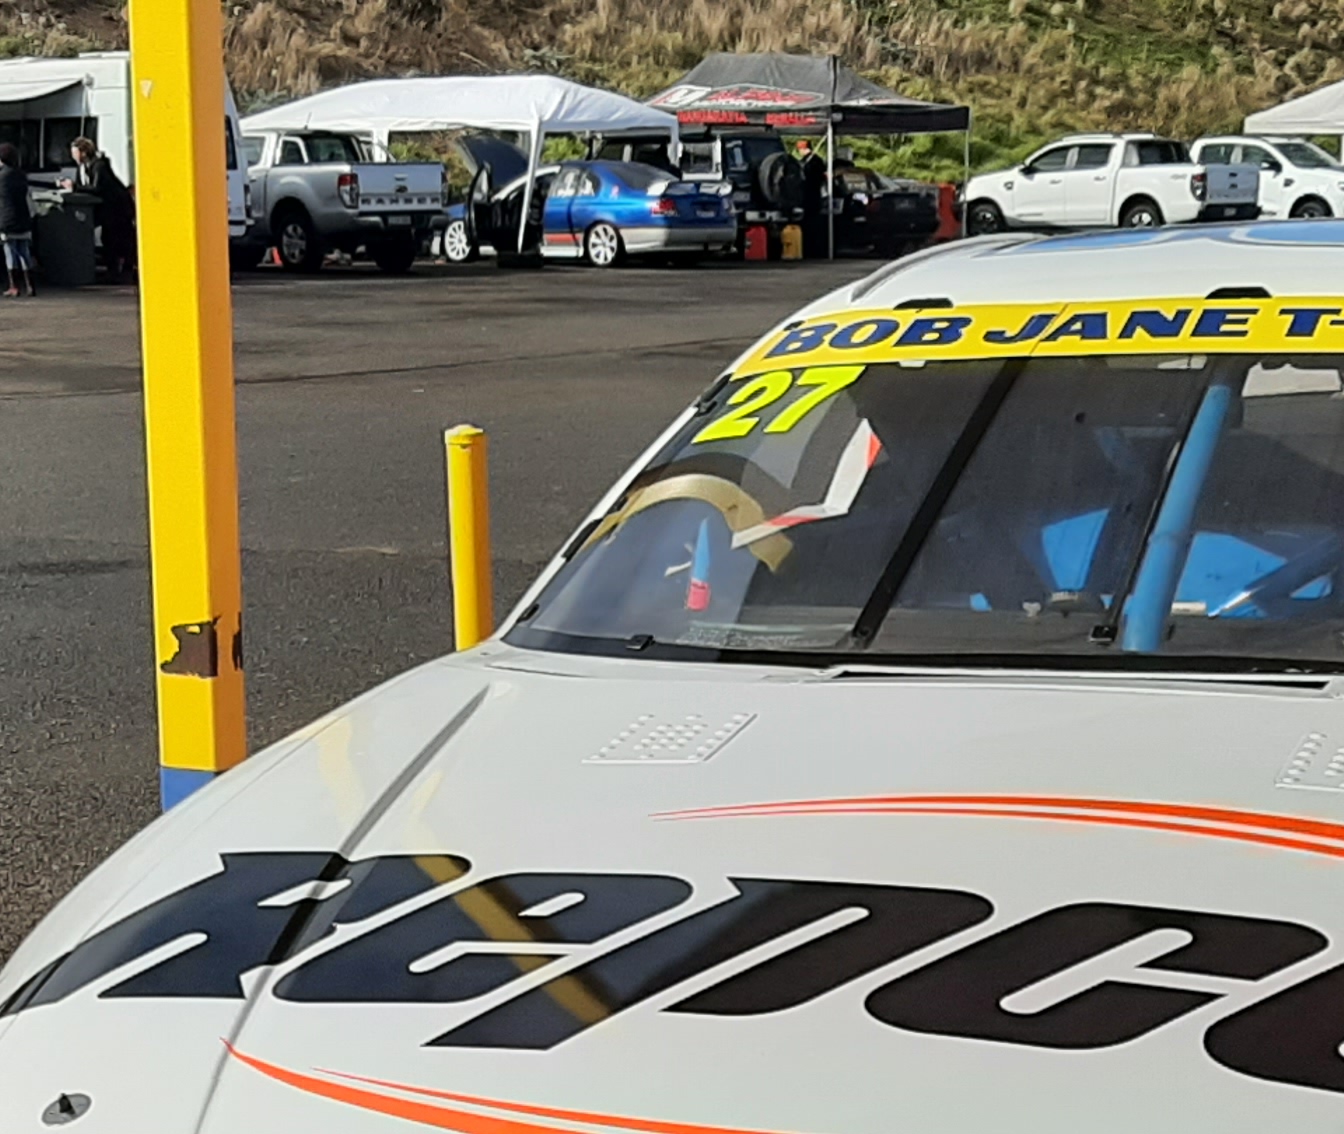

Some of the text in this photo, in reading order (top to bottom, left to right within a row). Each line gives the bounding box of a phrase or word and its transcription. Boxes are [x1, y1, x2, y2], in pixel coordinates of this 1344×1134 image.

[765, 315, 972, 358] BOB
[982, 308, 1260, 345] JANE
[692, 363, 867, 445] 27
